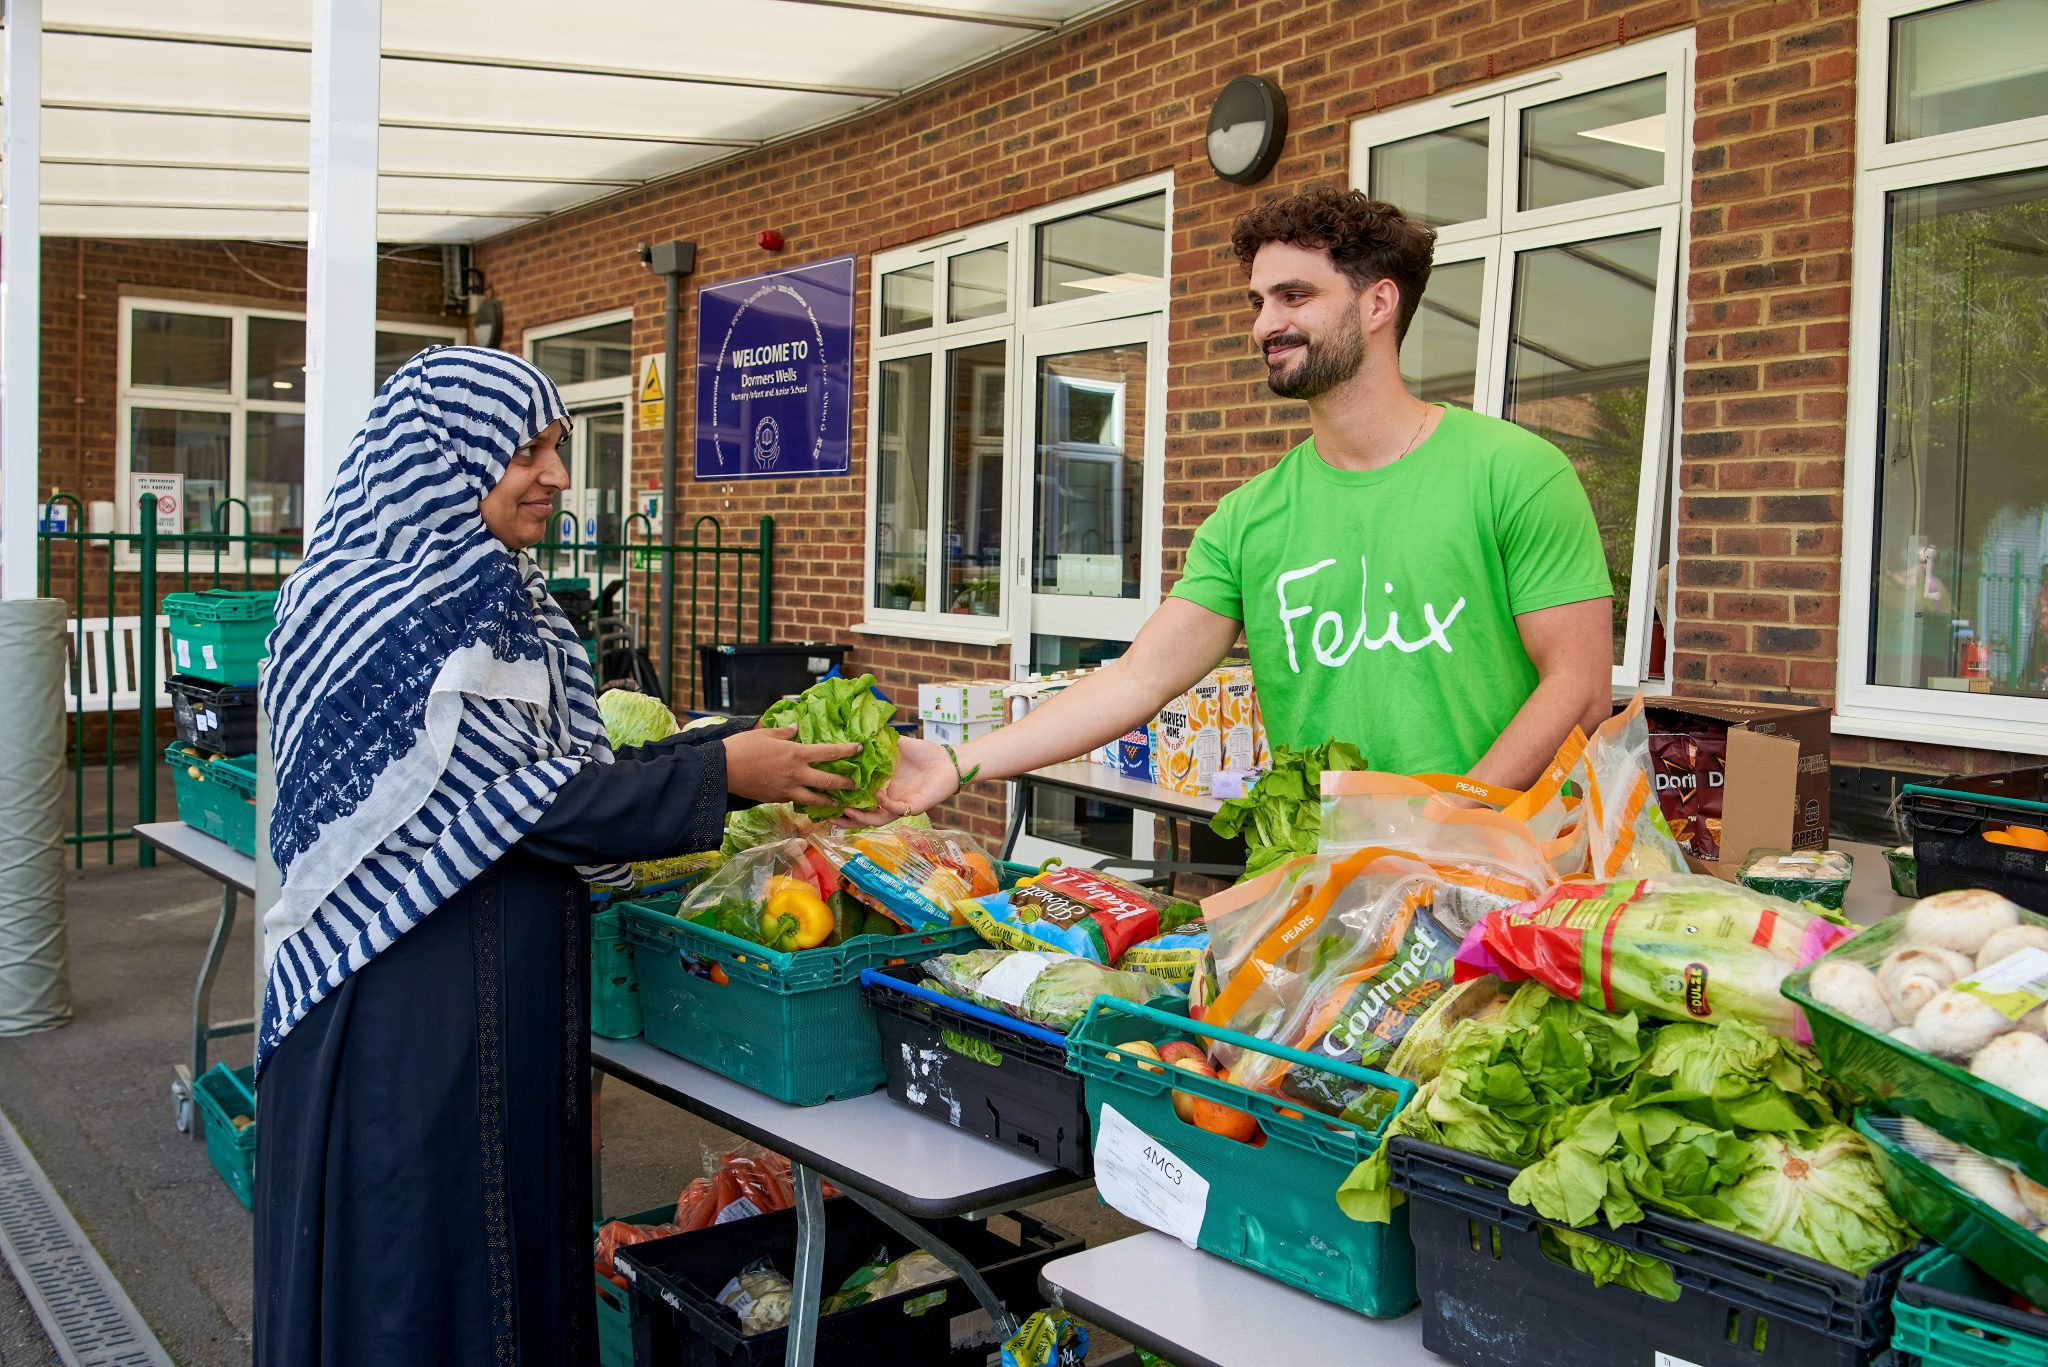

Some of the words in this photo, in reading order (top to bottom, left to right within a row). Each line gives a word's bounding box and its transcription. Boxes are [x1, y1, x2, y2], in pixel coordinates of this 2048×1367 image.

[732, 343, 790, 369] WELCOME
[791, 340, 808, 360] TO
[741, 374, 775, 388] Dormers
[775, 367, 797, 383] Wells
[1277, 554, 1466, 674] Felix
[1196, 686, 1217, 695] HARVEST
[1229, 684, 1249, 693] HARVEST
[1160, 709, 1187, 729] HARVEST
[1166, 725, 1180, 739] HOME
[1455, 781, 1488, 798] PEARS
[1806, 812, 1819, 821] KING
[904, 889, 925, 907] PEPPERS
[1077, 880, 1148, 921] Baby
[1280, 915, 1315, 944] PEARS
[1322, 925, 1439, 1057] Gourmet
[1374, 978, 1442, 1041] PEARS
[1142, 1146, 1184, 1186] 4MC3
